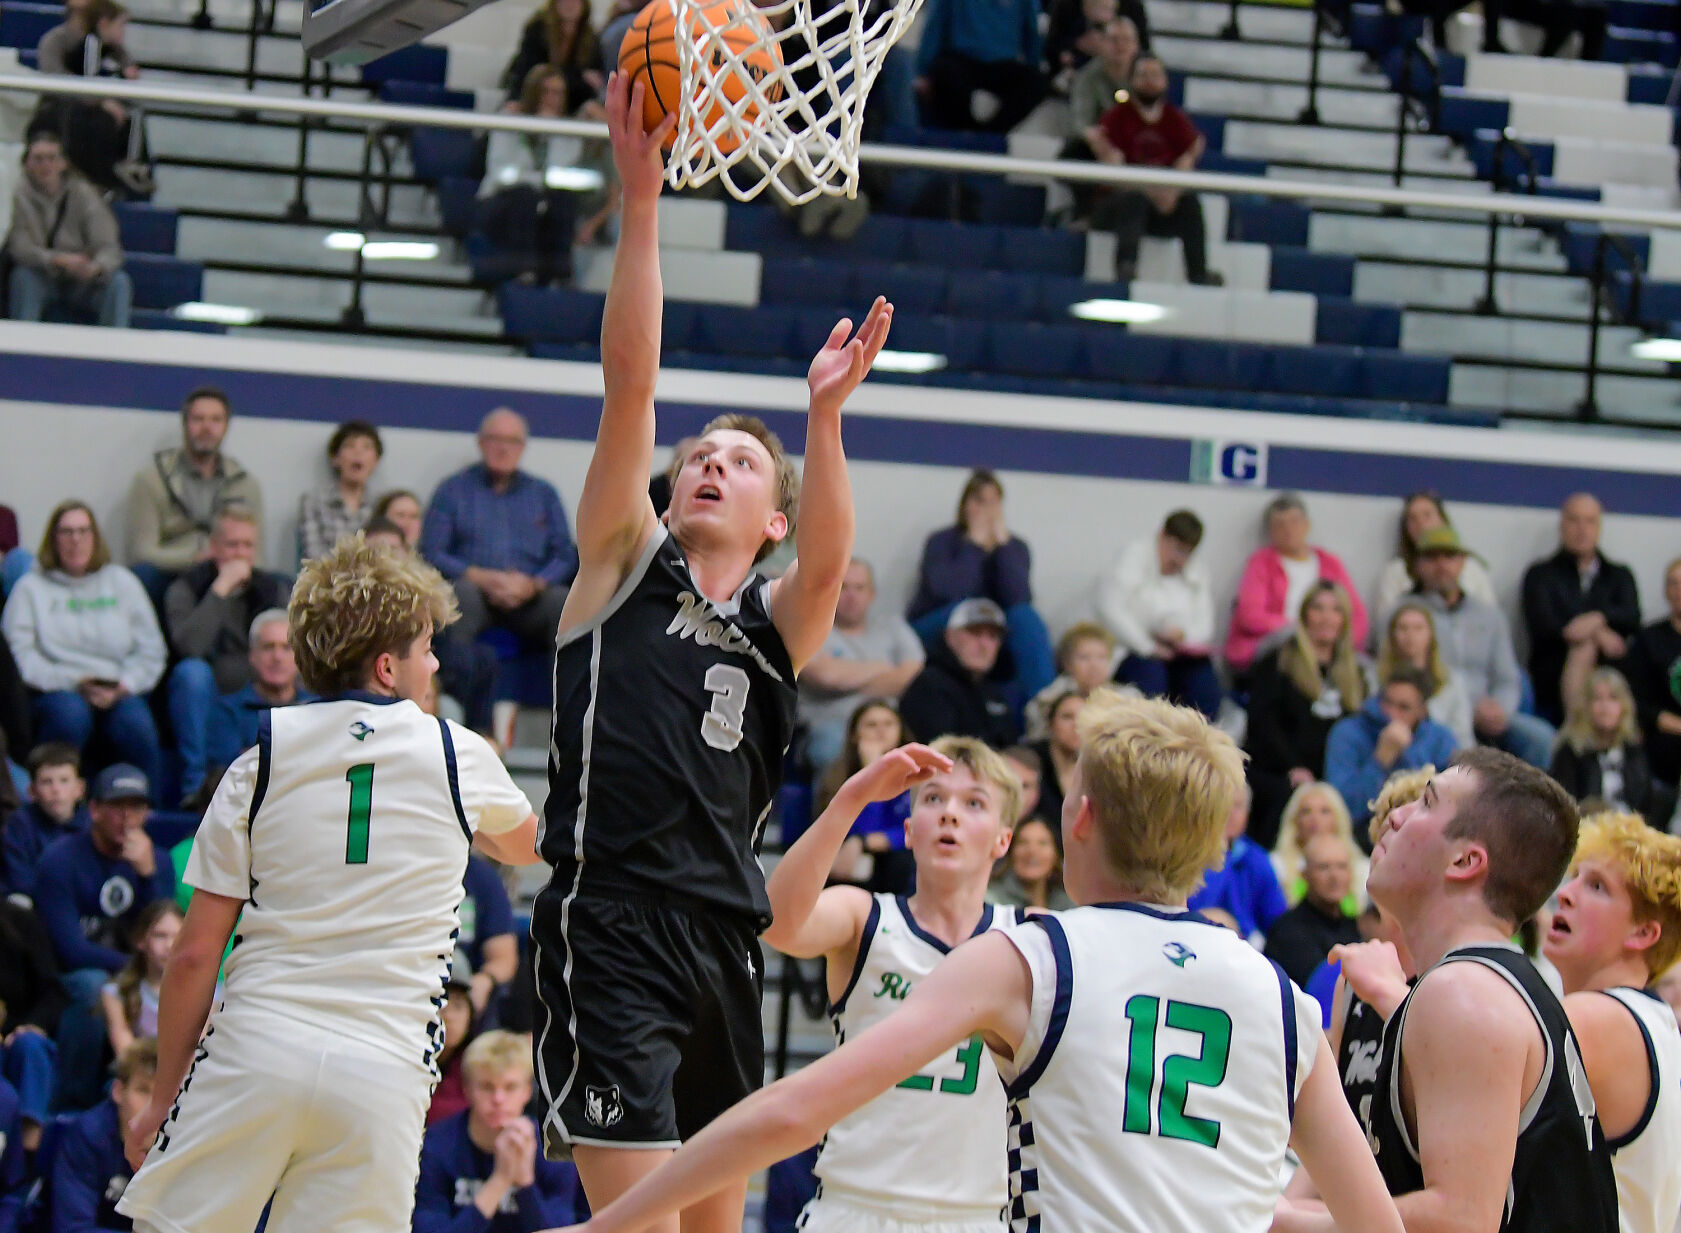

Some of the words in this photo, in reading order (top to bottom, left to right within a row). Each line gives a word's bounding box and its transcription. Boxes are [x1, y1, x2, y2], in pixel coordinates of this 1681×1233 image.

[1222, 444, 1258, 480] G
[701, 662, 750, 752] 3
[346, 763, 375, 864] 1
[1122, 994, 1232, 1149] 12
